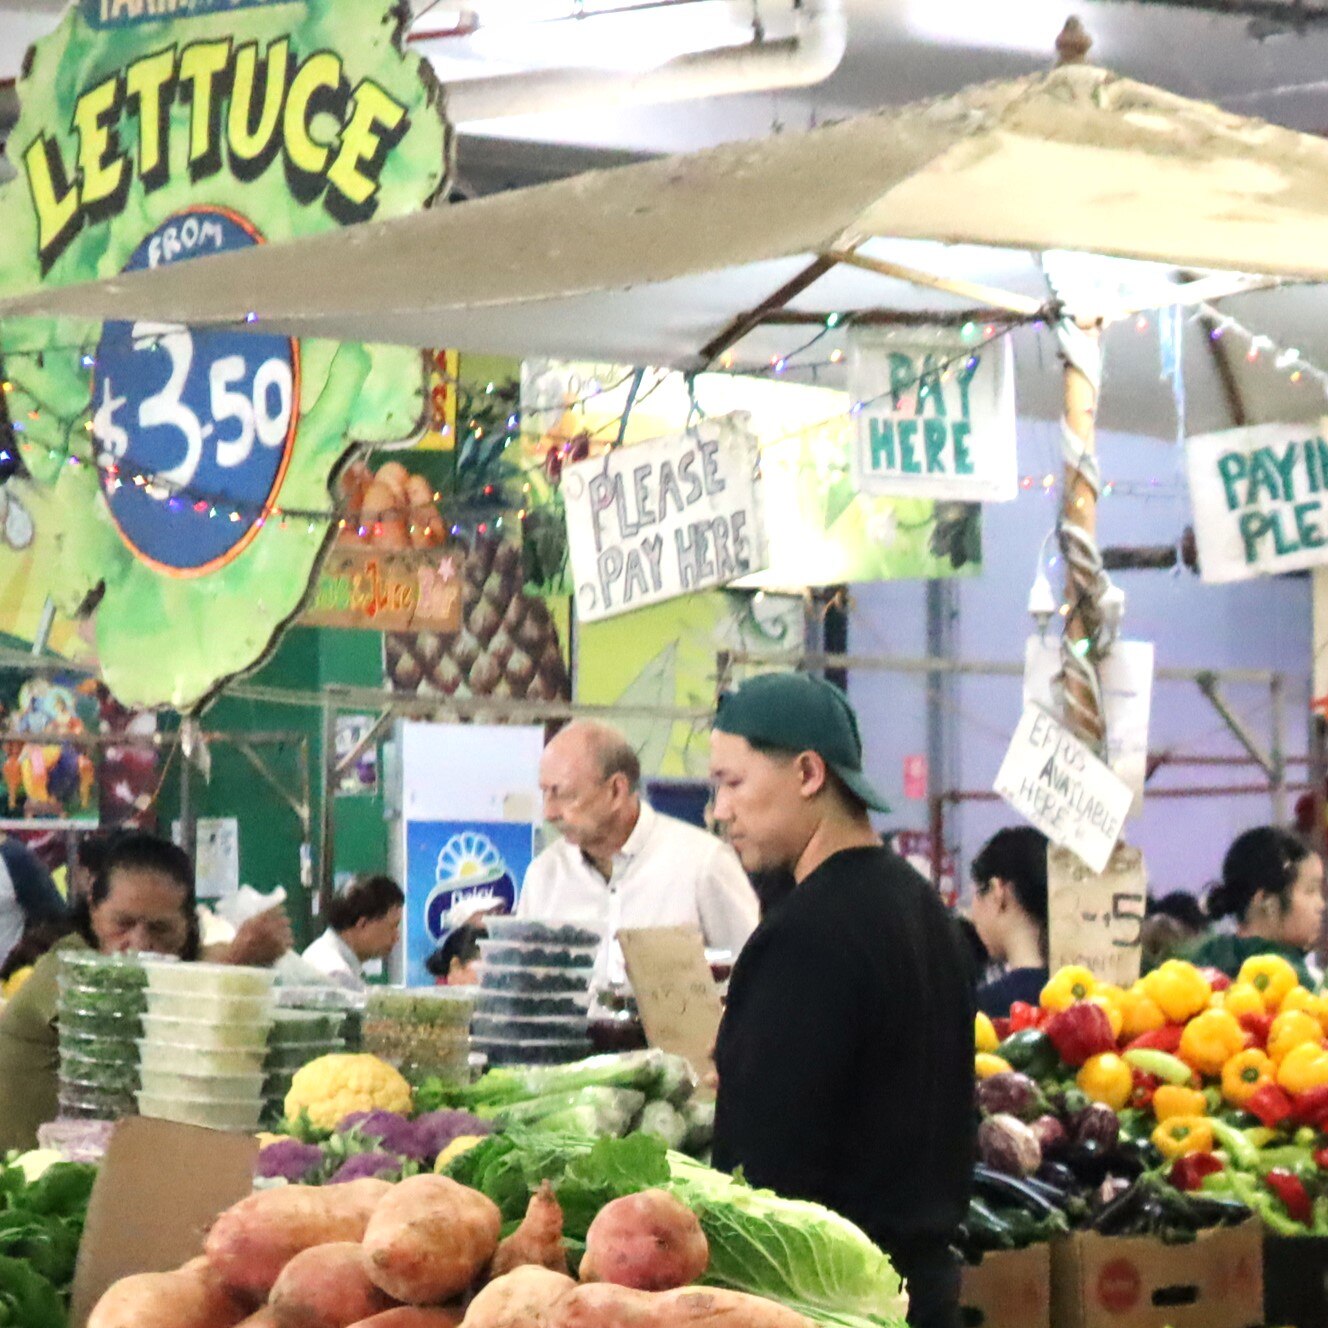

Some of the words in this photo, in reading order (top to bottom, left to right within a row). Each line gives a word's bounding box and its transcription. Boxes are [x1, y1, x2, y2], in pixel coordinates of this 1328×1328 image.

[22, 36, 408, 276] LETTUCE
[147, 217, 224, 269] FROM
[93, 320, 293, 499] $3.50
[888, 350, 983, 420] PAY
[869, 416, 976, 474] HERE
[1217, 437, 1302, 511] PAY
[588, 440, 727, 551] PLEASE
[596, 532, 664, 610] PAY
[676, 510, 750, 589] HERE
